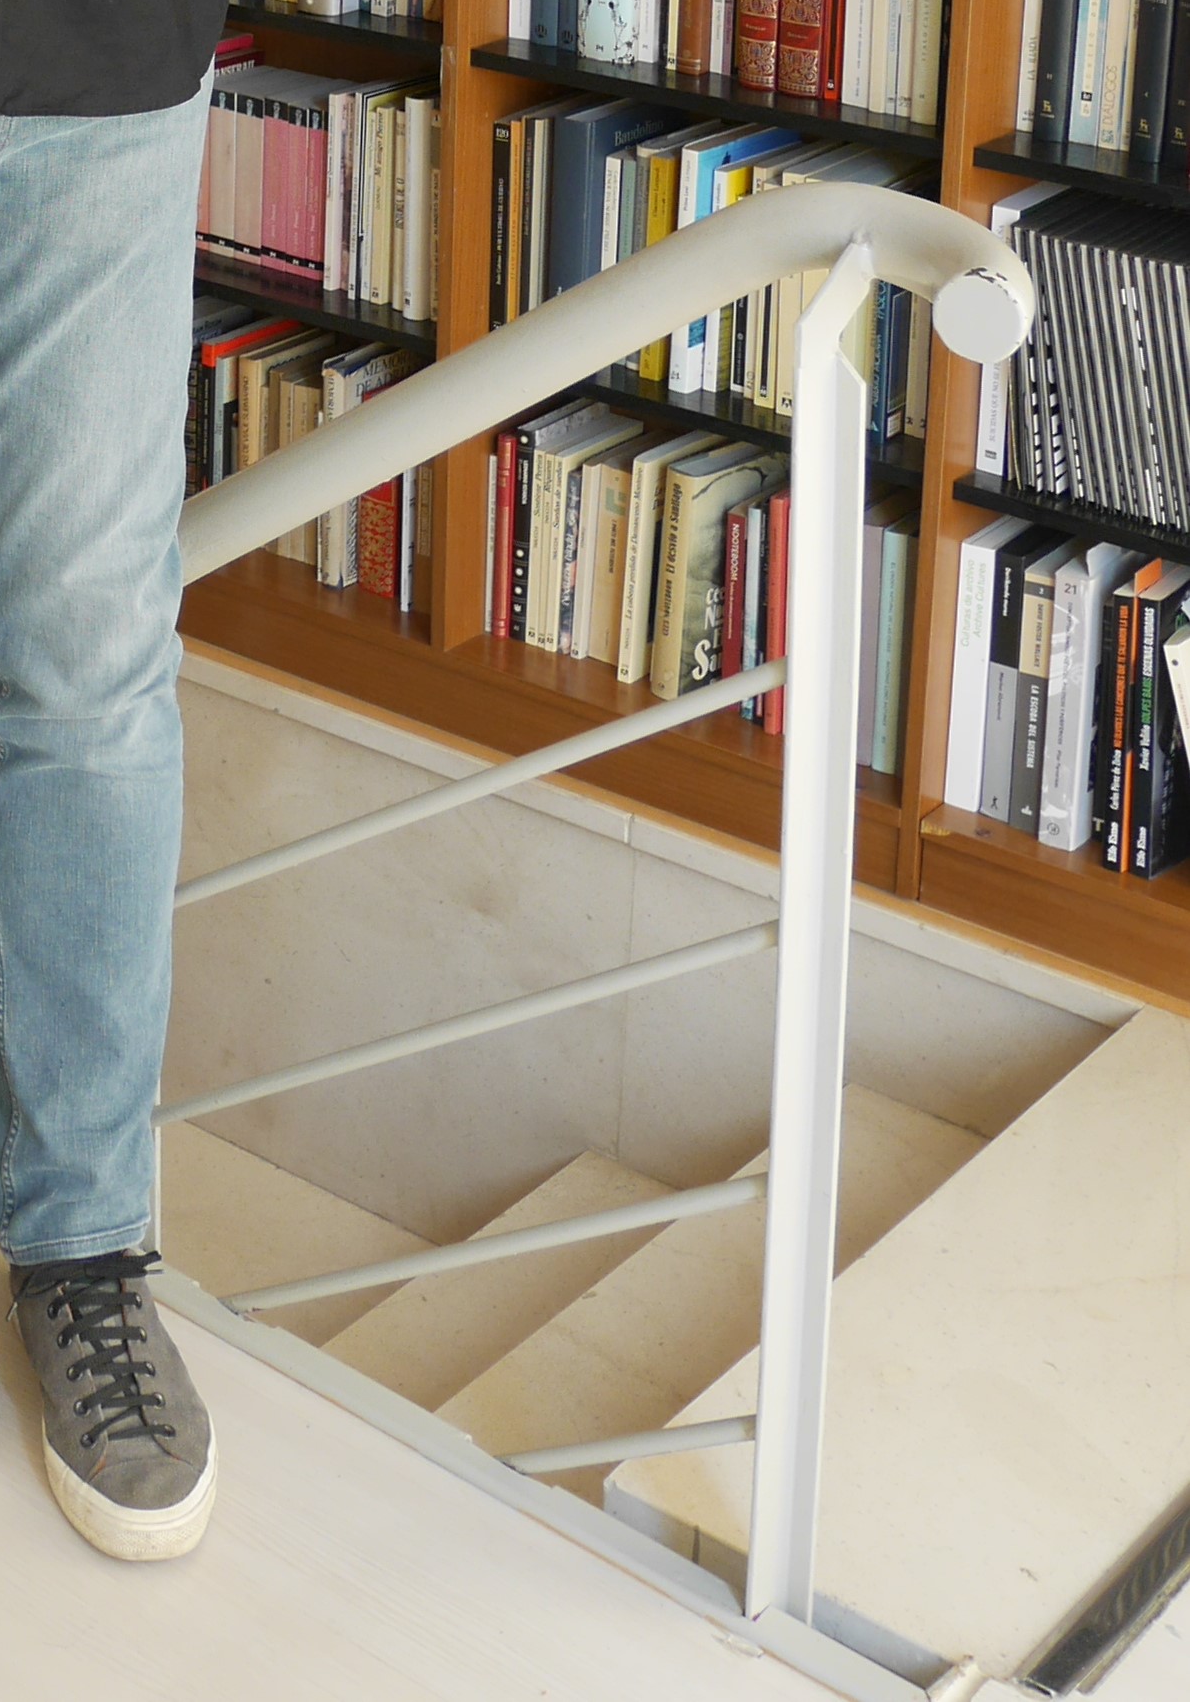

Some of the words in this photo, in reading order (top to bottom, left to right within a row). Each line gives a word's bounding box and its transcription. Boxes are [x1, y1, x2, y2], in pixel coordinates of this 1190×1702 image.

[666, 565, 675, 574] El
[729, 523, 739, 581] NOOTEBOOM
[964, 559, 975, 592] archivo
[975, 563, 986, 601] Cultures
[962, 594, 973, 605] de
[960, 608, 973, 647] Culturas
[972, 603, 984, 638] Archive
